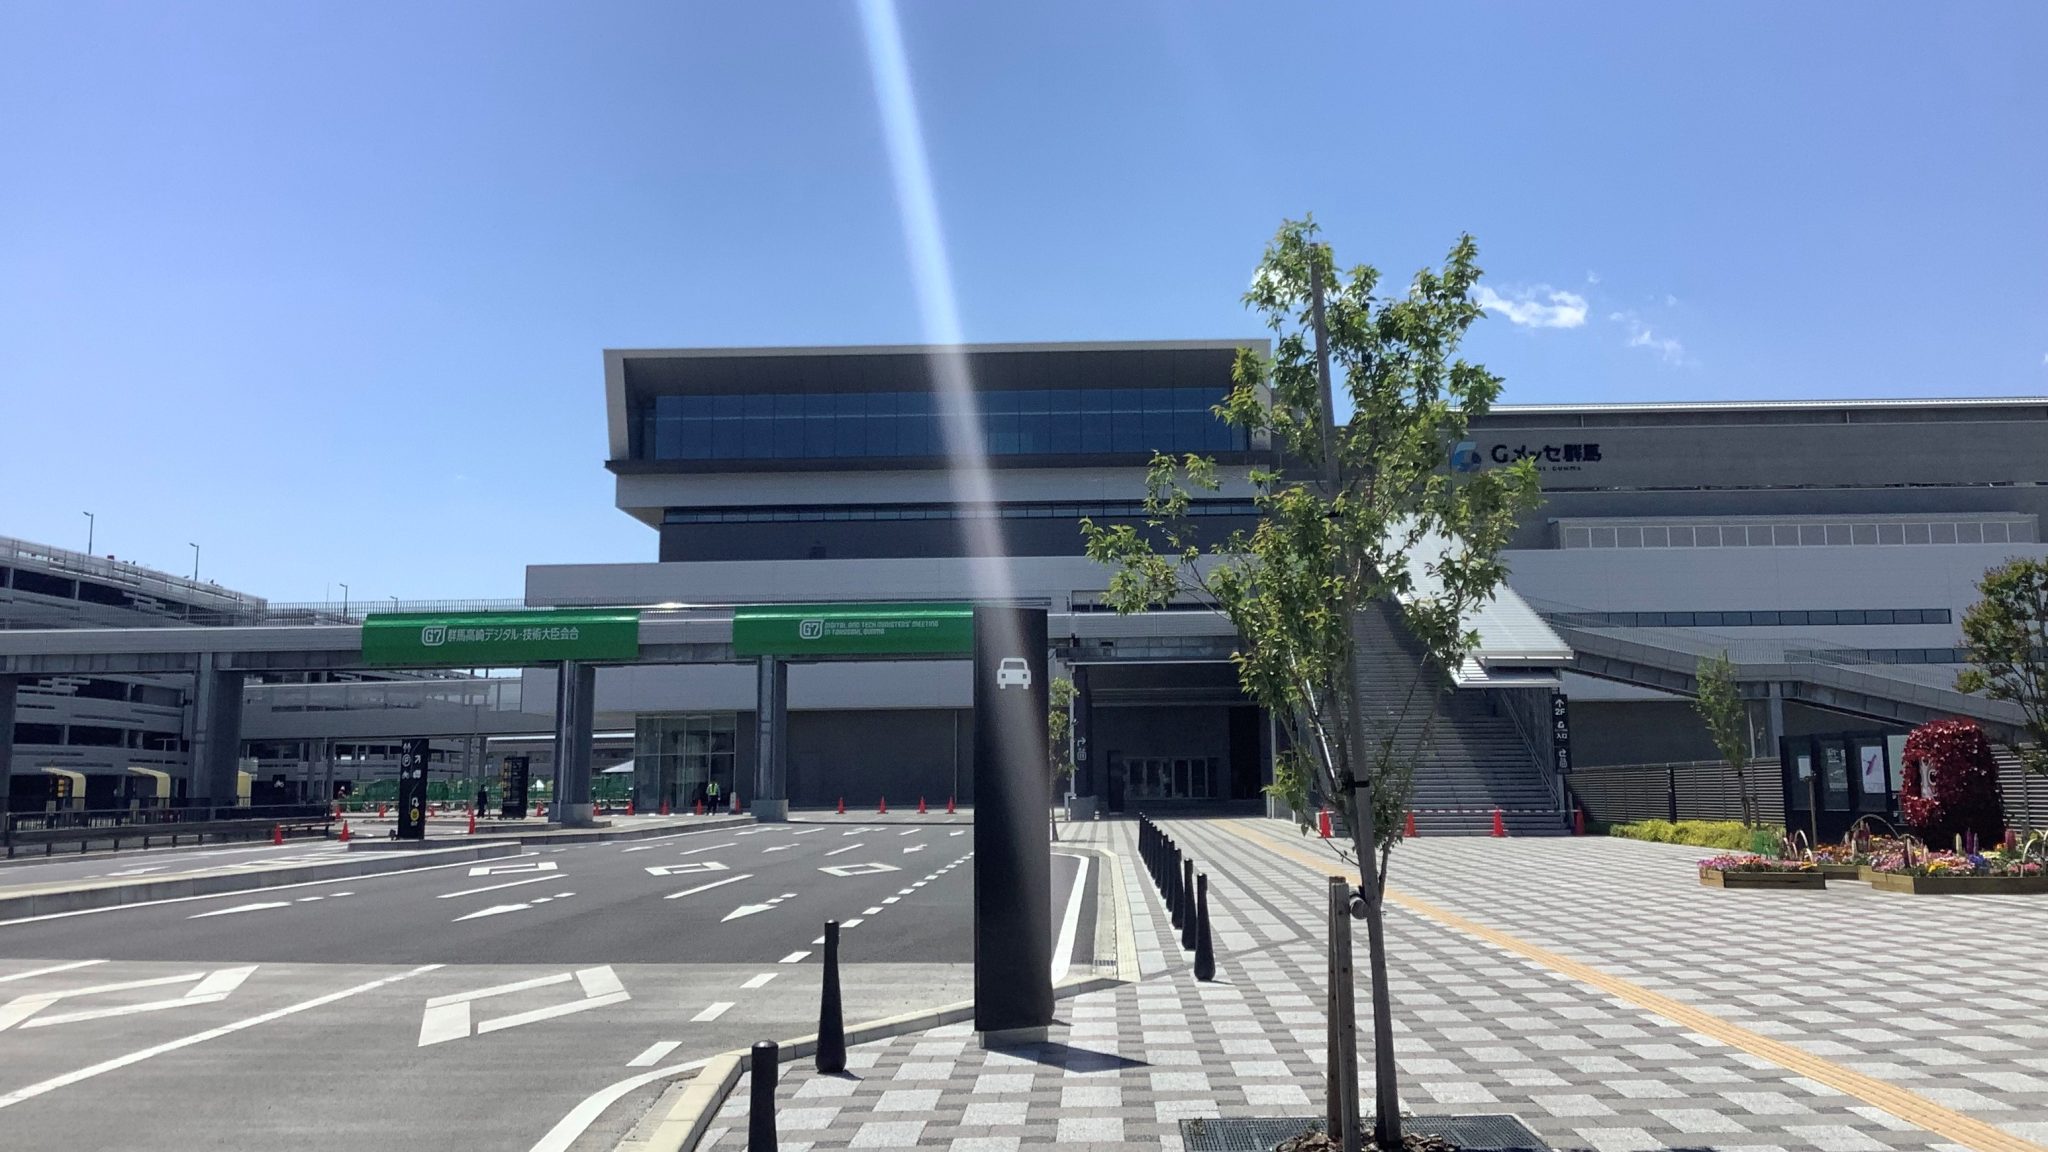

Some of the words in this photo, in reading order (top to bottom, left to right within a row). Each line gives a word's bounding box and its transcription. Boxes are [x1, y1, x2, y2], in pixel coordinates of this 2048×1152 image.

[1491, 443, 1602, 464] Gメッセ群馬
[424, 628, 444, 644] G7
[802, 622, 821, 637] G7
[1555, 708, 1566, 716] 2F
